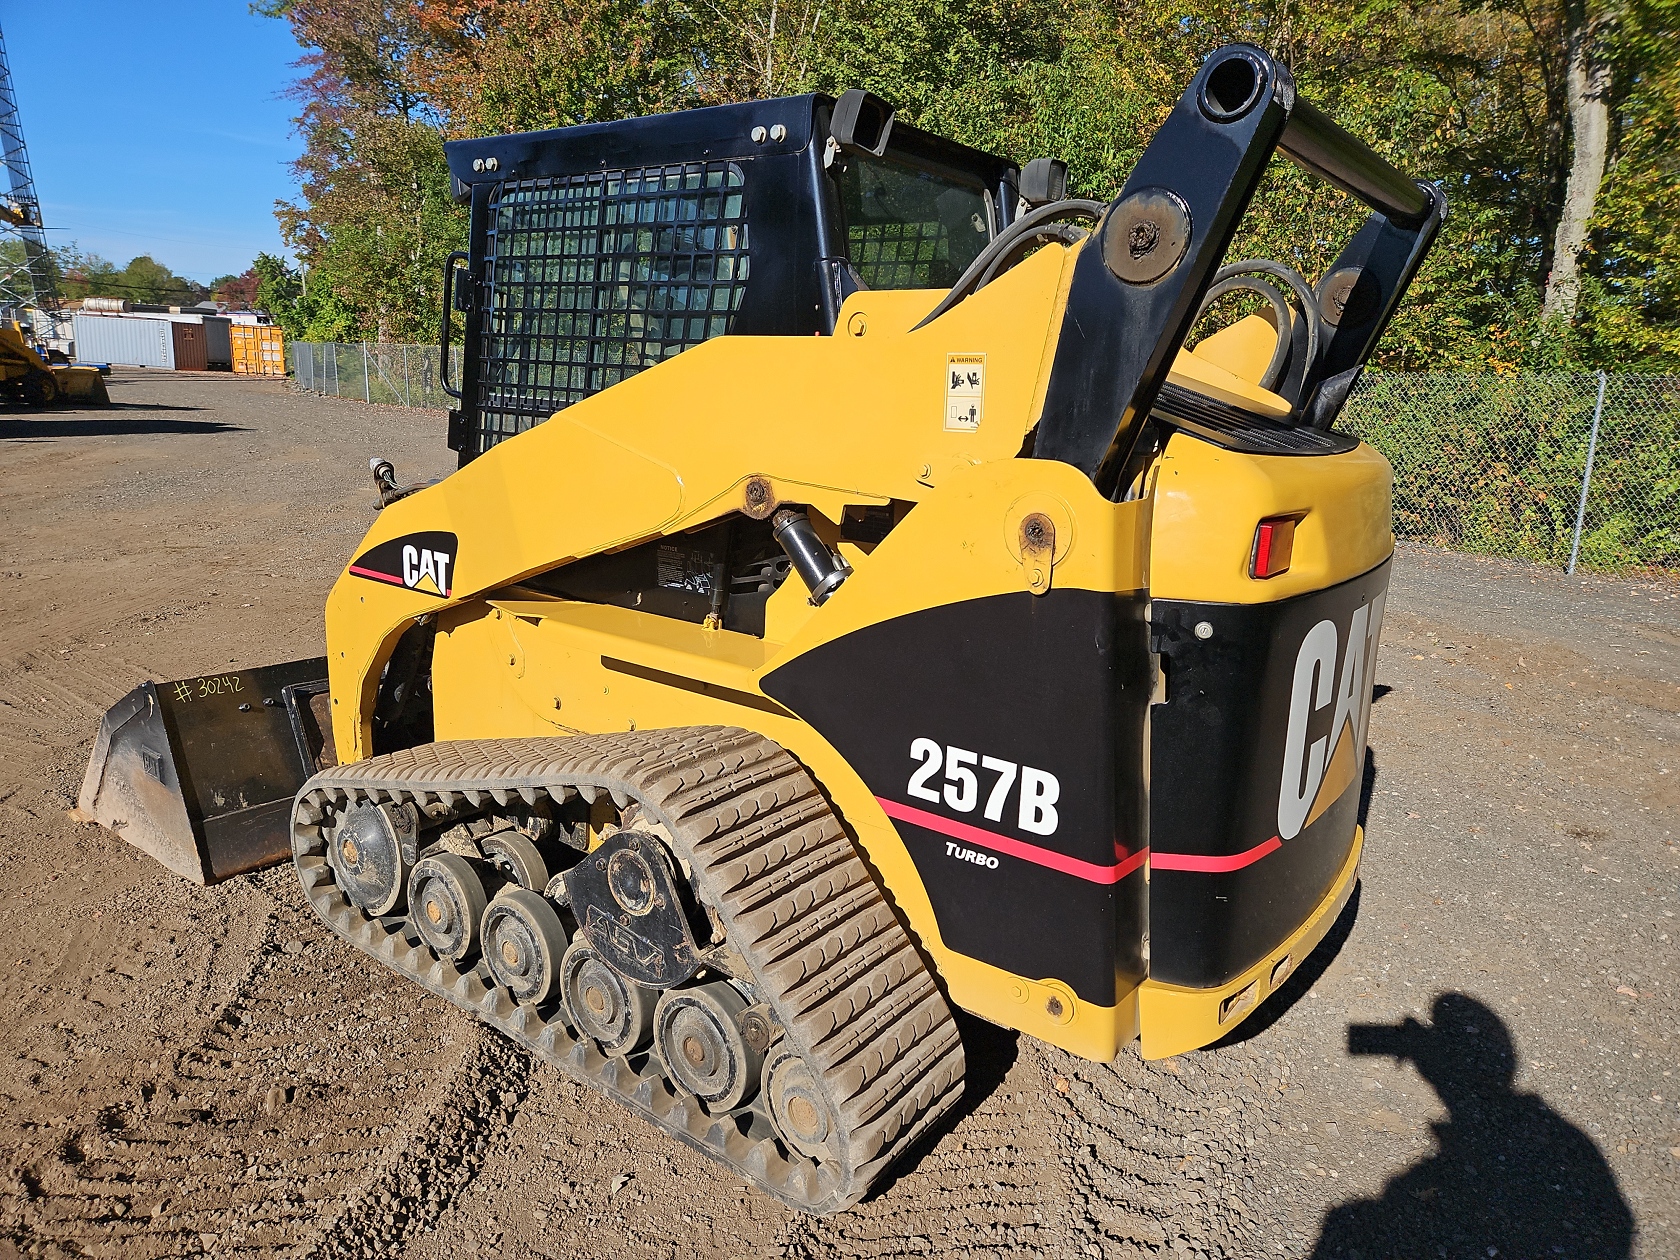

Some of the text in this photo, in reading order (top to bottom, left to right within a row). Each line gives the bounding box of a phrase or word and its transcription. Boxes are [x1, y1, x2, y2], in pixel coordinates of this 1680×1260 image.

[660, 544, 678, 552] NOTICE
[402, 544, 450, 596] CAT
[197, 676, 245, 698] 30242
[907, 737, 1061, 836] 257B
[945, 841, 1000, 870] TURBO
